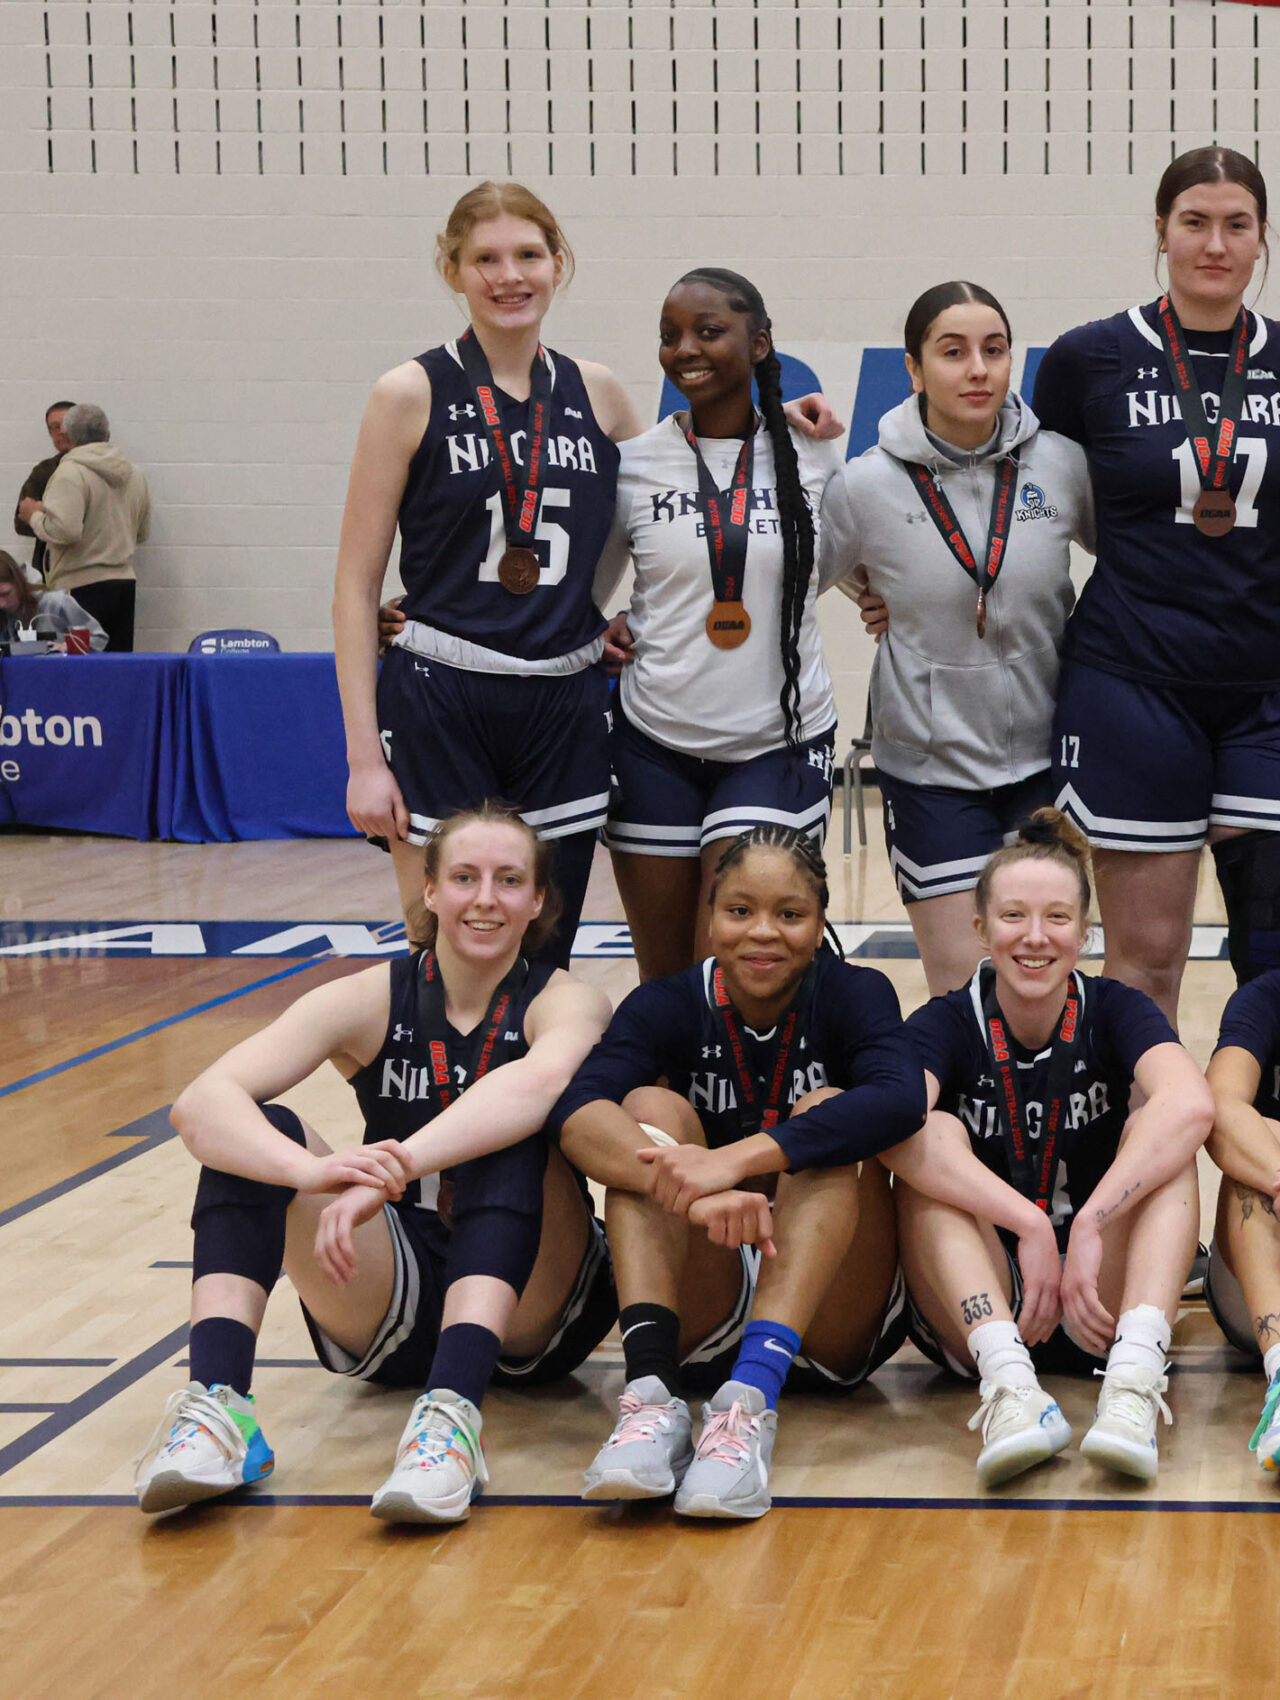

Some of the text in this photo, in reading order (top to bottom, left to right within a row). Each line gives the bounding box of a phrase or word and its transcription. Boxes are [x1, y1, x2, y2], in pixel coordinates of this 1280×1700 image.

[1162, 310, 1180, 360] BASKETBALL
[476, 385, 501, 426] OCAA
[528, 434, 542, 486] BASKETBALL
[1216, 417, 1236, 458] OCAA
[1171, 437, 1268, 528] 17
[518, 489, 539, 533] OCAA
[730, 487, 748, 526] OCAA
[926, 482, 977, 569] OCAA BASKETBALL
[1015, 506, 1058, 521] KNIGHTS
[478, 487, 571, 586] 15
[986, 536, 1005, 578] OCAA
[996, 484, 1010, 534] BASKETBALL
[220, 638, 270, 648] Lambton
[1060, 735, 1080, 768] 17
[1059, 998, 1079, 1043] OCAA
[428, 1040, 451, 1086] OCAA
[988, 1018, 1010, 1063] OCAA
[1000, 1066, 1018, 1126] BASKETBALL
[1038, 1134, 1056, 1194] BASKETBALL
[960, 1293, 993, 1325] 333
